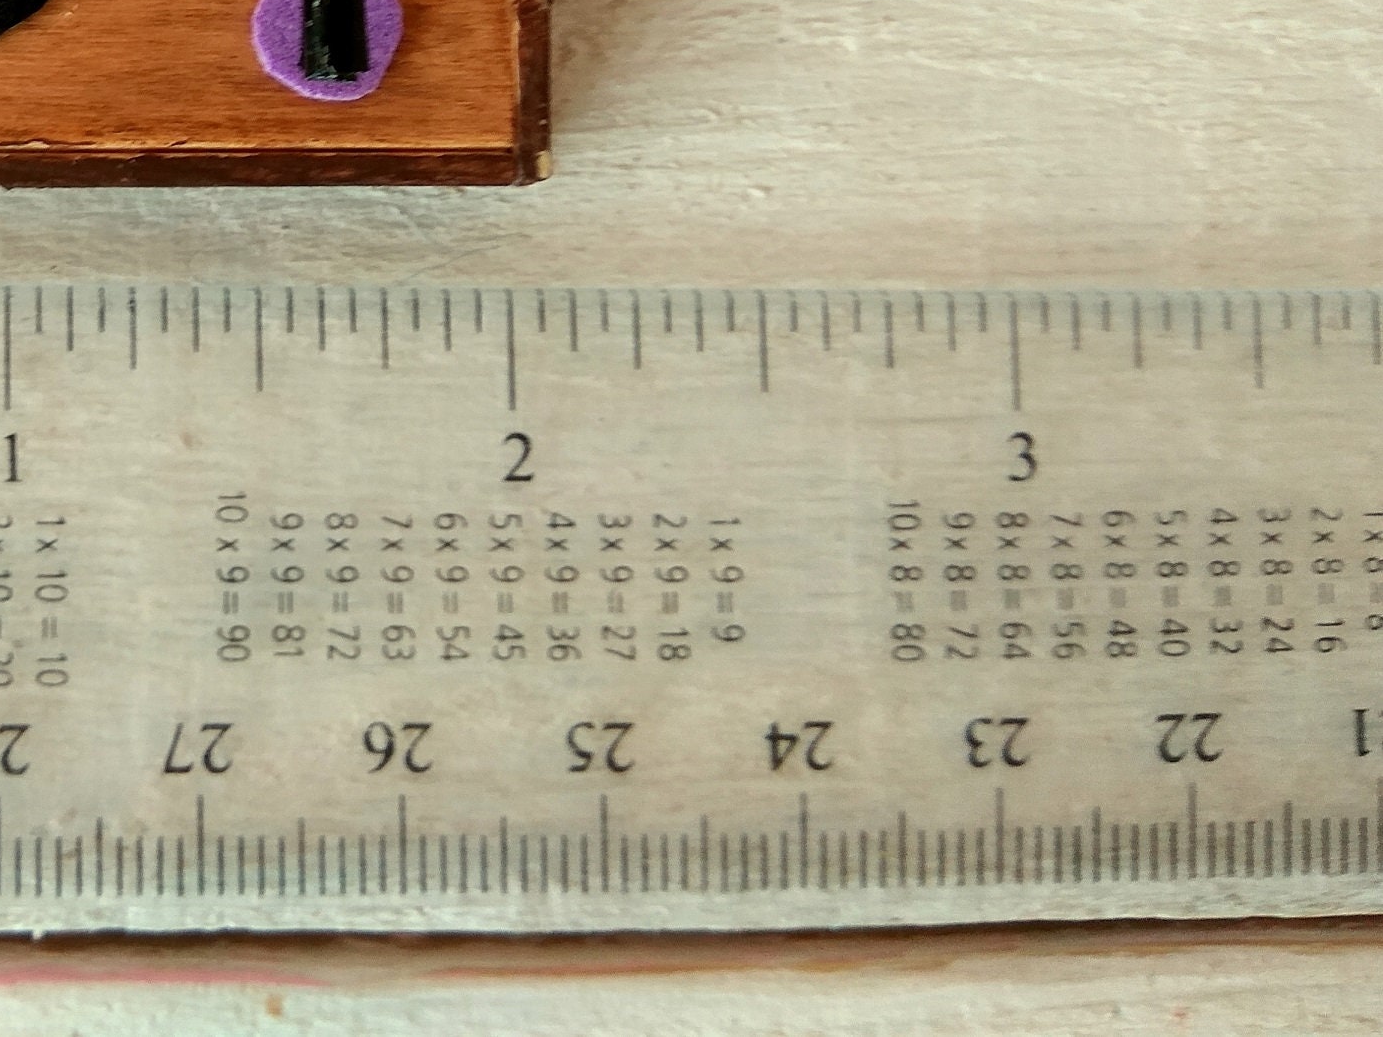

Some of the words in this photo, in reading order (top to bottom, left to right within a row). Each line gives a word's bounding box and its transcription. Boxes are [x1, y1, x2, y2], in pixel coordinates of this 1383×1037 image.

[5, 433, 21, 483] 1
[503, 432, 534, 483] 2
[1008, 432, 1038, 482] 3
[215, 491, 249, 524] 10
[886, 500, 922, 532] 10
[1209, 508, 1239, 525] 4
[1257, 509, 1292, 523] 3
[1309, 507, 1343, 521] 2
[36, 515, 67, 527] 1
[269, 513, 304, 531] 9
[324, 512, 359, 530] 8
[381, 516, 413, 529] 7
[434, 513, 468, 531] 6
[488, 514, 523, 530] 5
[547, 512, 576, 530] 4
[598, 514, 633, 529] 3
[652, 513, 688, 529] 2
[708, 516, 742, 527] 1
[942, 512, 976, 530] 9
[995, 512, 1031, 529] 8
[1050, 514, 1084, 527] 7
[1101, 510, 1136, 528] 6
[1155, 510, 1188, 526] 5
[216, 566, 250, 584] 9
[270, 565, 305, 584] 9
[326, 565, 360, 584] 9
[381, 565, 414, 584] 9
[436, 566, 469, 584] 9
[489, 565, 525, 584] 9
[545, 565, 580, 584] 9
[600, 565, 634, 584] 9
[654, 566, 689, 584] 9
[711, 565, 745, 584] 9
[888, 565, 923, 582] 8
[943, 564, 977, 583] 8
[997, 564, 1031, 582] 8
[1050, 563, 1083, 581] 8
[1103, 562, 1137, 579] 8
[1156, 561, 1188, 578] 8
[1207, 560, 1240, 577] 8
[1260, 559, 1293, 576] 8
[1311, 558, 1344, 575] 8
[34, 569, 68, 603] 10
[271, 624, 307, 657] 81
[327, 626, 362, 661] 72
[381, 625, 416, 662] 63
[492, 624, 526, 661] 45
[600, 625, 637, 661] 27
[710, 624, 746, 644] 9
[889, 623, 926, 663] 80
[945, 625, 980, 660] 72
[999, 622, 1032, 660] 64
[1051, 622, 1086, 660] 56
[1105, 620, 1137, 658] 48
[1158, 618, 1191, 657] 40
[1209, 618, 1244, 654] 32
[1261, 617, 1295, 654] 24
[1314, 620, 1347, 653] 16
[215, 625, 251, 663] 90
[436, 626, 471, 662] 54
[547, 627, 582, 661] 36
[657, 628, 691, 662] 18
[35, 653, 70, 688] 10
[764, 721, 834, 772] 24
[964, 717, 1030, 769] 23
[1156, 713, 1222, 763] 22
[162, 723, 233, 775] 27
[362, 722, 432, 774] 26
[566, 721, 635, 776] 25
